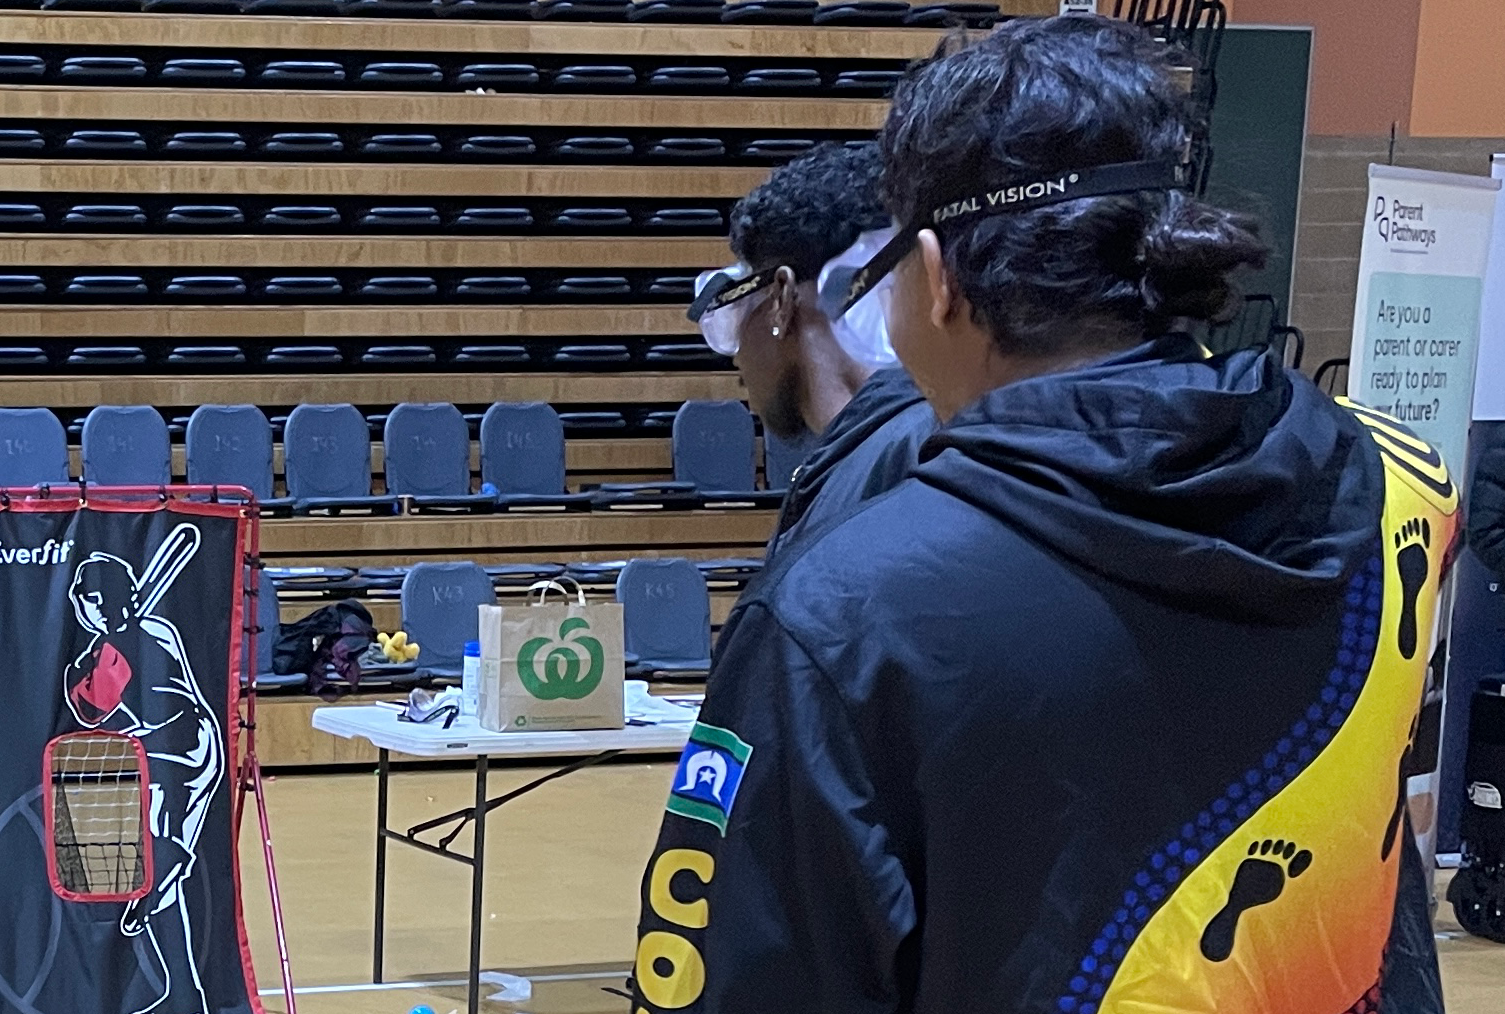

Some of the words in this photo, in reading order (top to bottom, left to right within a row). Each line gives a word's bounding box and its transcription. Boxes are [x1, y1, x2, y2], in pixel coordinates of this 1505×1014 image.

[932, 197, 981, 224] FATAL
[987, 178, 1065, 205] VISION
[1392, 199, 1423, 221] Parent
[1391, 221, 1436, 248] Pathways
[1377, 299, 1395, 323] Are
[1396, 305, 1421, 329] you
[1422, 307, 1431, 324] a
[1373, 336, 1410, 361] parent
[1414, 339, 1428, 356] or
[1430, 340, 1461, 357] carer
[1370, 366, 1403, 395] ready
[1406, 367, 1419, 389] to
[1420, 366, 1447, 395] plan
[1395, 398, 1439, 421] future?
